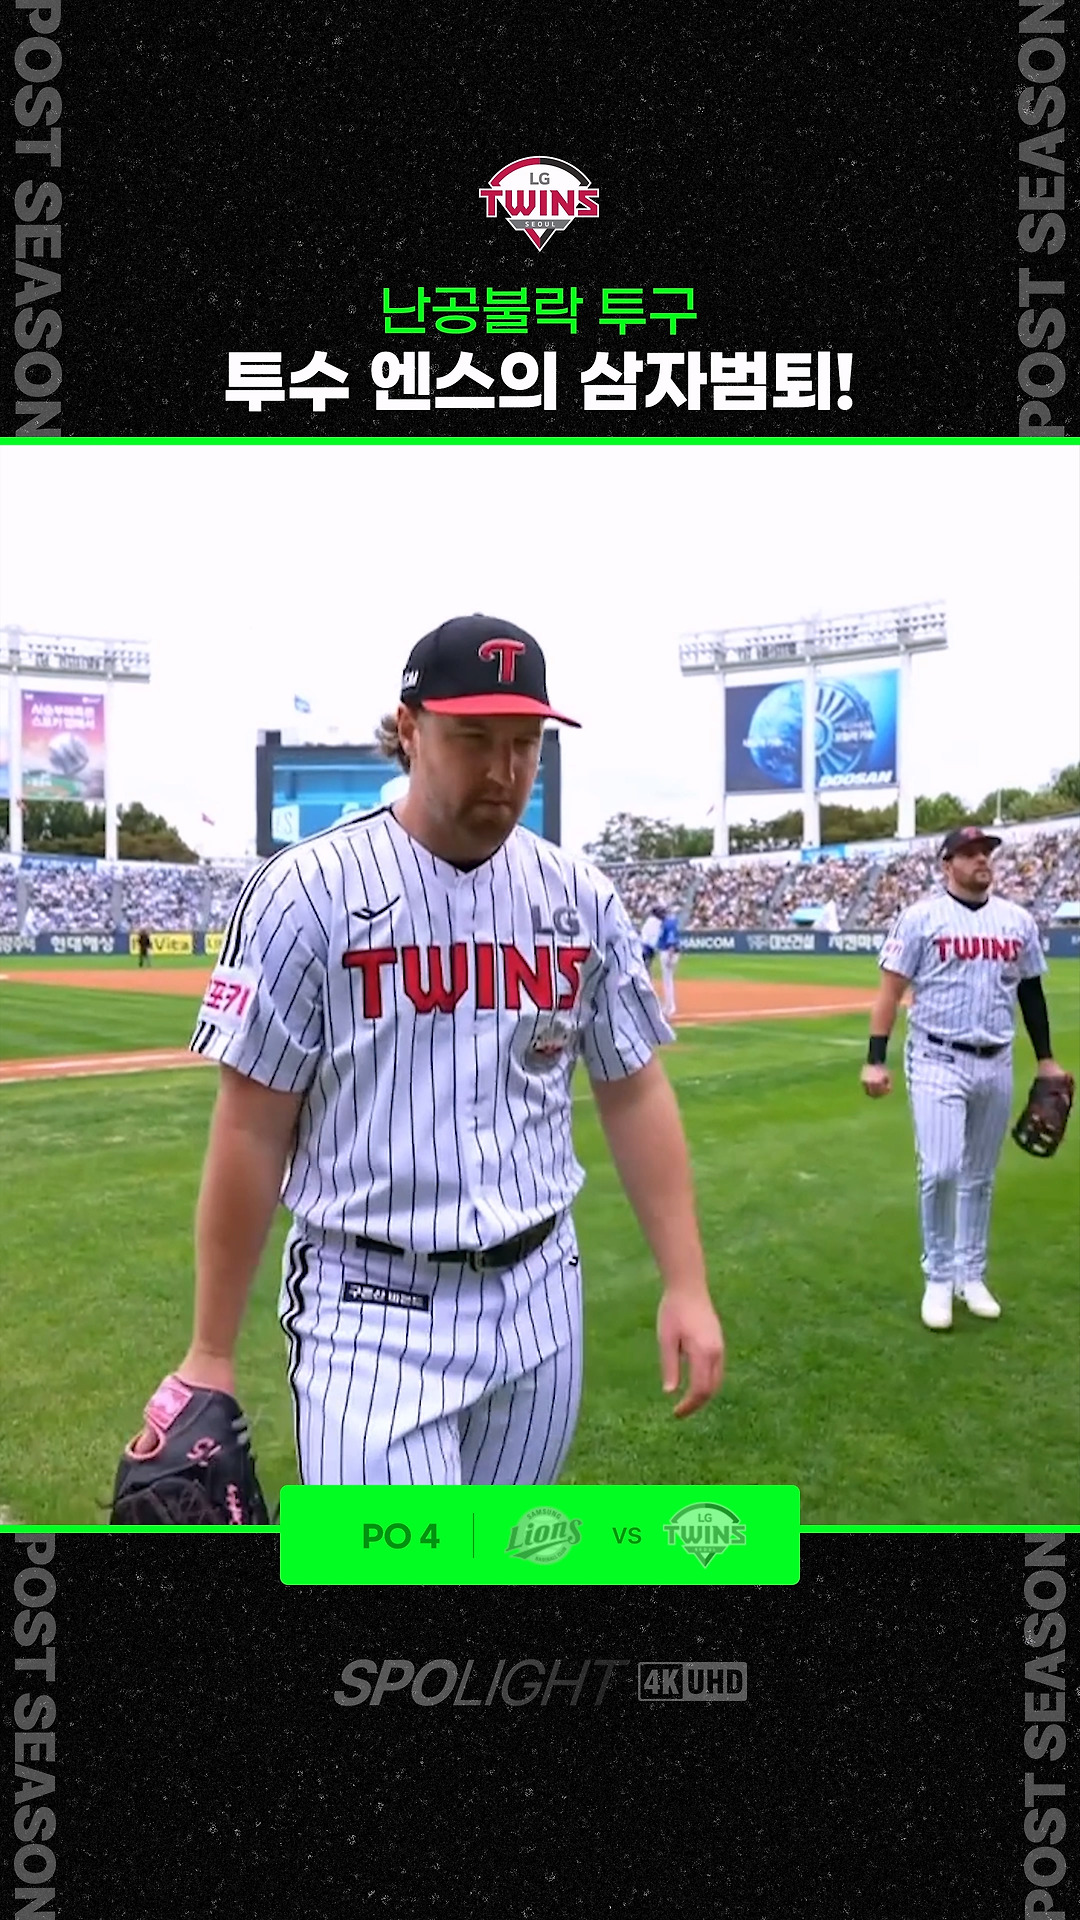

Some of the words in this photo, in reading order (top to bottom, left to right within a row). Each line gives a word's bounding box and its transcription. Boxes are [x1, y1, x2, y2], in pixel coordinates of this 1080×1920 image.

[479, 638, 526, 683] T
[819, 770, 893, 787] DOOSAN
[531, 905, 580, 936] LG
[933, 937, 1024, 962] TWINS
[342, 943, 591, 1018] TWINS
[203, 980, 251, 1016] 포키
